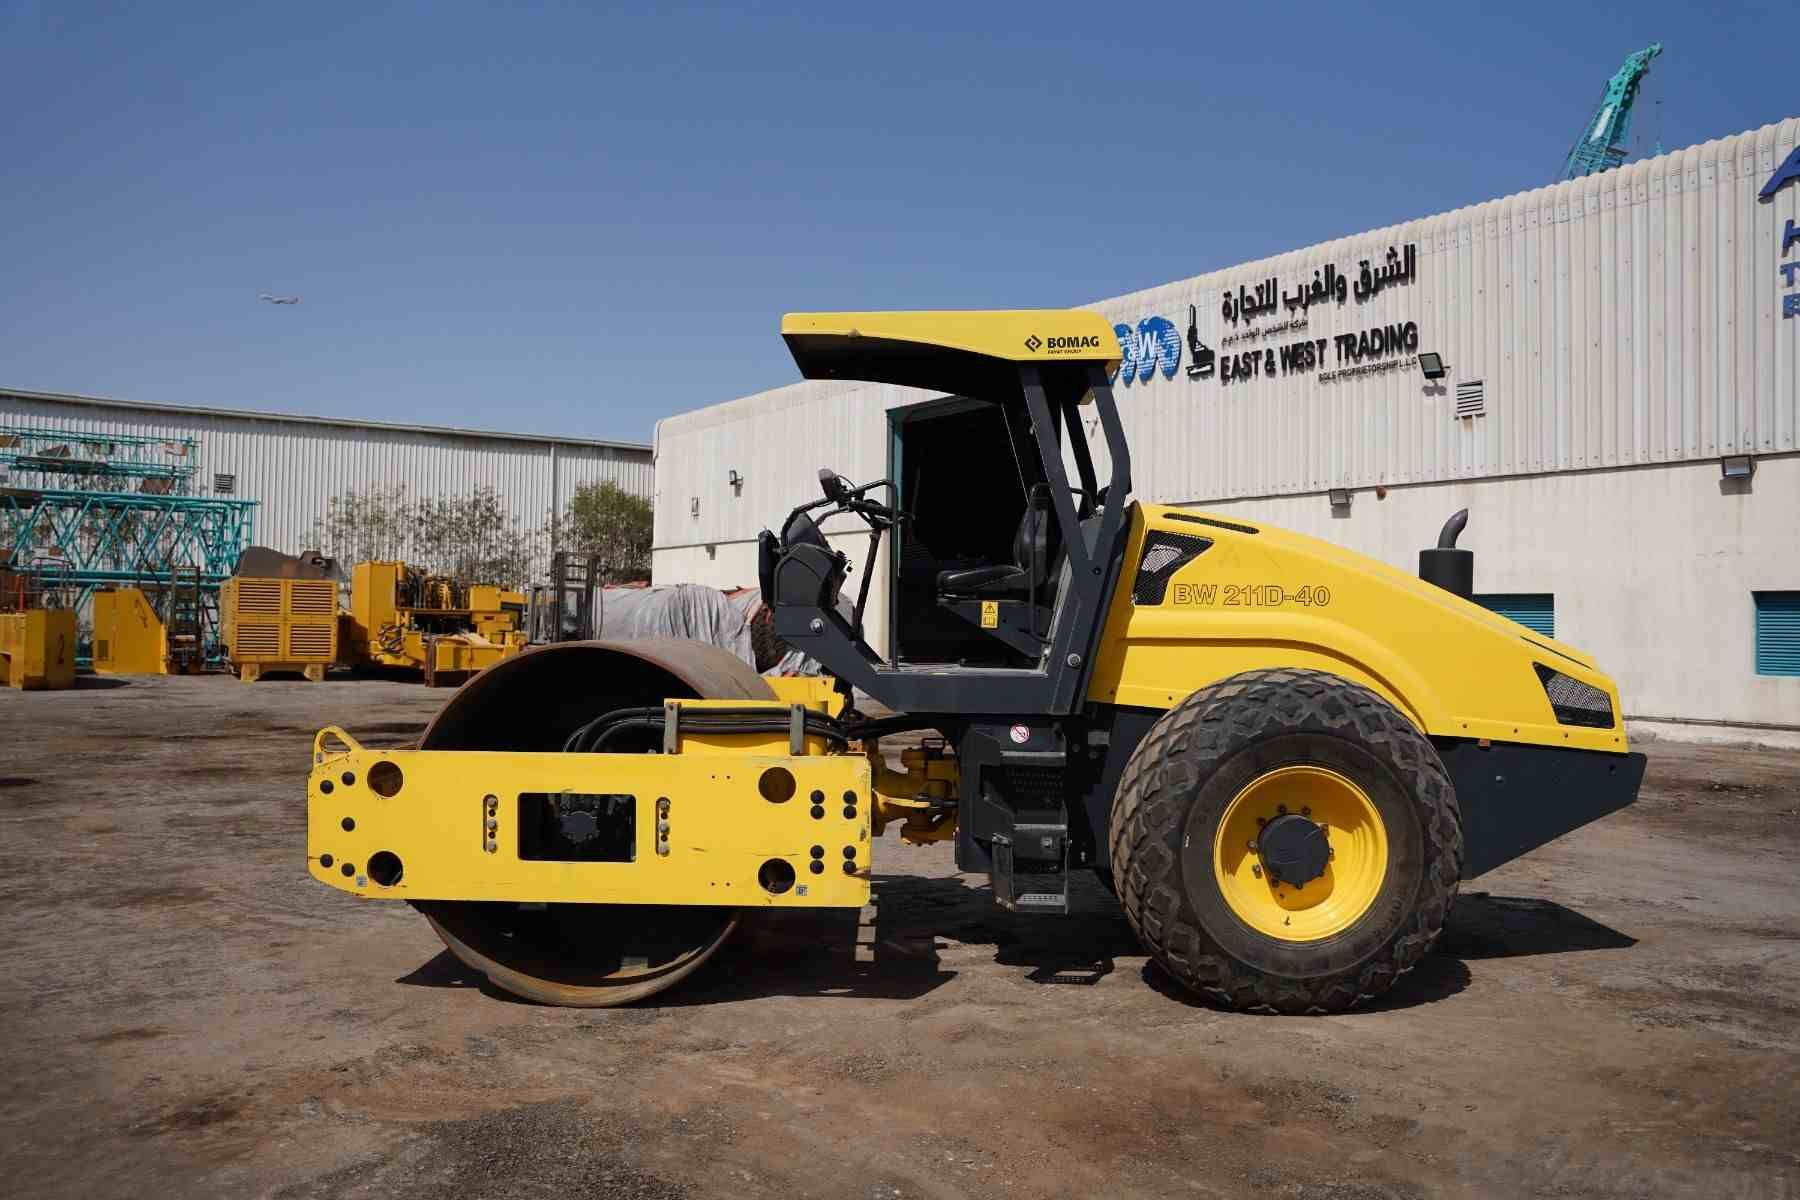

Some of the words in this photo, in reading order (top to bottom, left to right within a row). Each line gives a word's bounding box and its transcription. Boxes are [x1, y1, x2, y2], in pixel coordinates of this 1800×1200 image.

[1282, 263, 1347, 314] والغرب
[1353, 243, 1416, 300] الشرق
[1222, 276, 1278, 324] للتجارة
[1048, 336, 1100, 348] BOMAG
[1220, 349, 1262, 382] EAST
[1264, 347, 1276, 375] &
[1279, 338, 1327, 374] WEST
[1333, 321, 1419, 364] TRADING
[1173, 583, 1218, 605] BW
[1223, 585, 1331, 607] 211D-40
